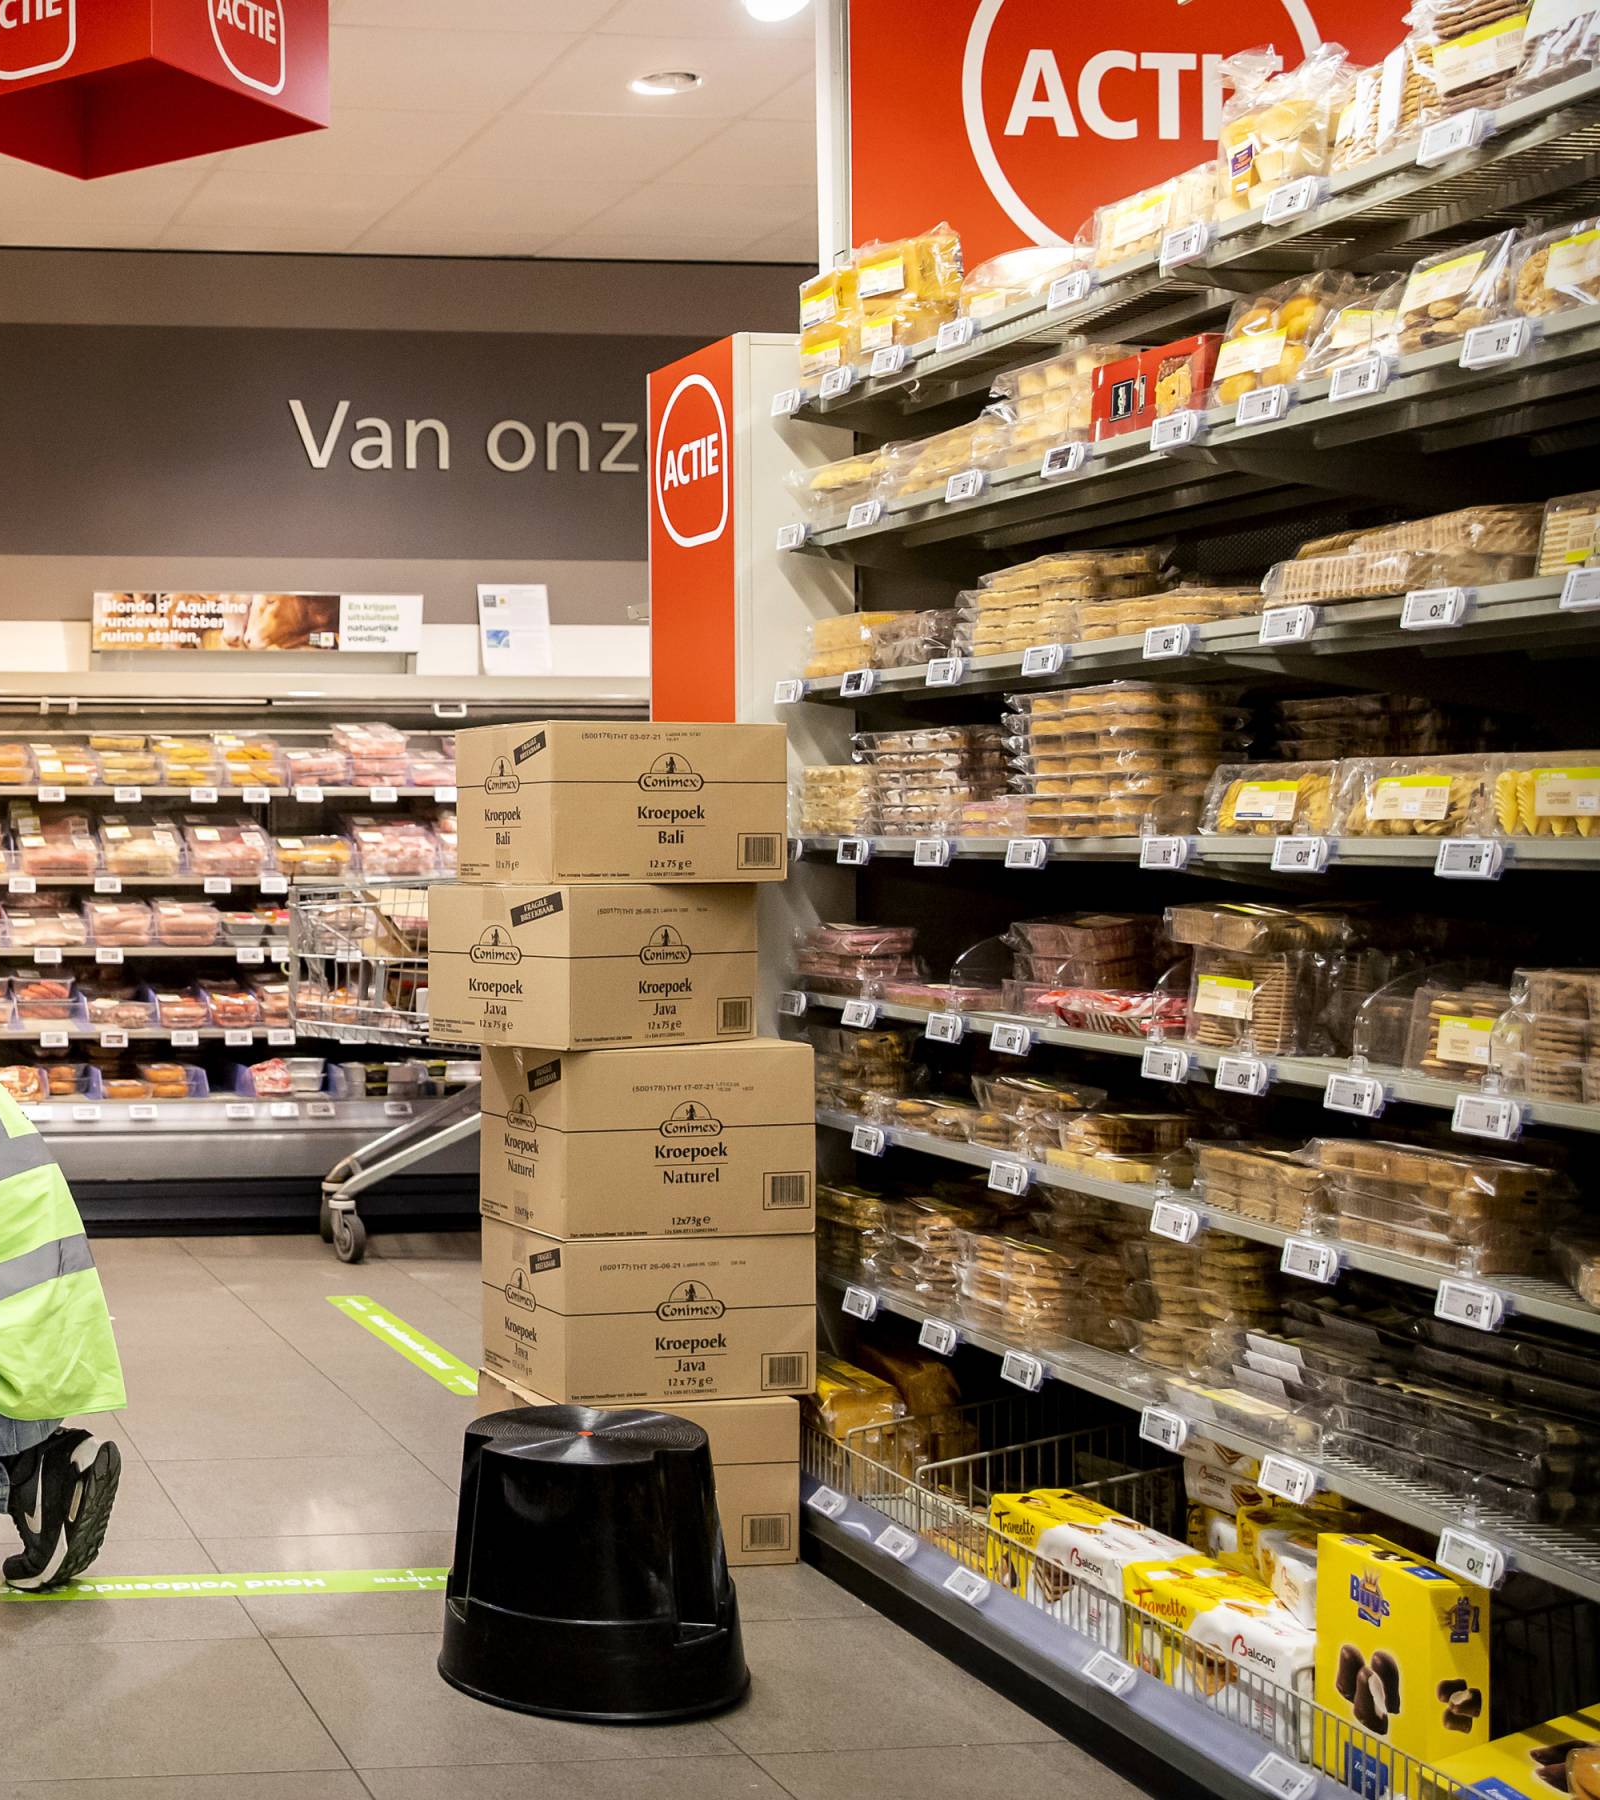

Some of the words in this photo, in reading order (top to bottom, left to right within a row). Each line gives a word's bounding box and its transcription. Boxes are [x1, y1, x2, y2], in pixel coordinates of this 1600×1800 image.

[216, 0, 277, 45] ACTIE
[1003, 48, 1283, 141] ACTI
[289, 399, 450, 470] Van
[663, 432, 720, 491] ACTIE
[101, 601, 155, 613] Blonde
[175, 601, 247, 616] Aquitaine
[347, 602, 360, 611] En
[362, 602, 397, 613] krijgen
[101, 616, 170, 628] runderen
[172, 614, 226, 628] hebben
[347, 623, 399, 633] natuurlijke
[101, 630, 145, 643] ruime
[147, 629, 200, 643] stallen.
[487, 779, 517, 791] Conimex
[643, 776, 697, 789] Conimex
[484, 805, 521, 824] Kroepoek
[637, 804, 705, 824] Kroepoek
[495, 831, 511, 846] Bali
[658, 830, 685, 845] Bali
[649, 859, 659, 869] 12
[667, 859, 677, 869] 75
[473, 947, 518, 962] Conimex
[644, 947, 687, 962] Conimex
[468, 977, 524, 998] Kroepoek
[638, 977, 692, 996] Kroepoek
[484, 1001, 508, 1016] Java
[653, 1001, 677, 1016] Java
[664, 1121, 717, 1135] Conimex
[504, 1133, 539, 1154] Kroepoek
[654, 1141, 728, 1162] Kroepoek
[508, 1158, 535, 1178] Naturel
[663, 1169, 720, 1185] Naturel
[671, 1215, 701, 1227] 12x73g
[661, 1304, 720, 1318] Conimex
[504, 1315, 537, 1342] Kroepoek
[655, 1333, 727, 1353] Kroepoek
[674, 1357, 706, 1373] Java
[668, 1377, 678, 1387] 12
[686, 1377, 697, 1386] 75
[1070, 1547, 1103, 1577] Balconi
[77, 1578, 240, 1594] voldoende
[244, 1576, 327, 1591] Houd
[1134, 1588, 1187, 1620] Trancetto
[1231, 1634, 1276, 1671] Balconi
